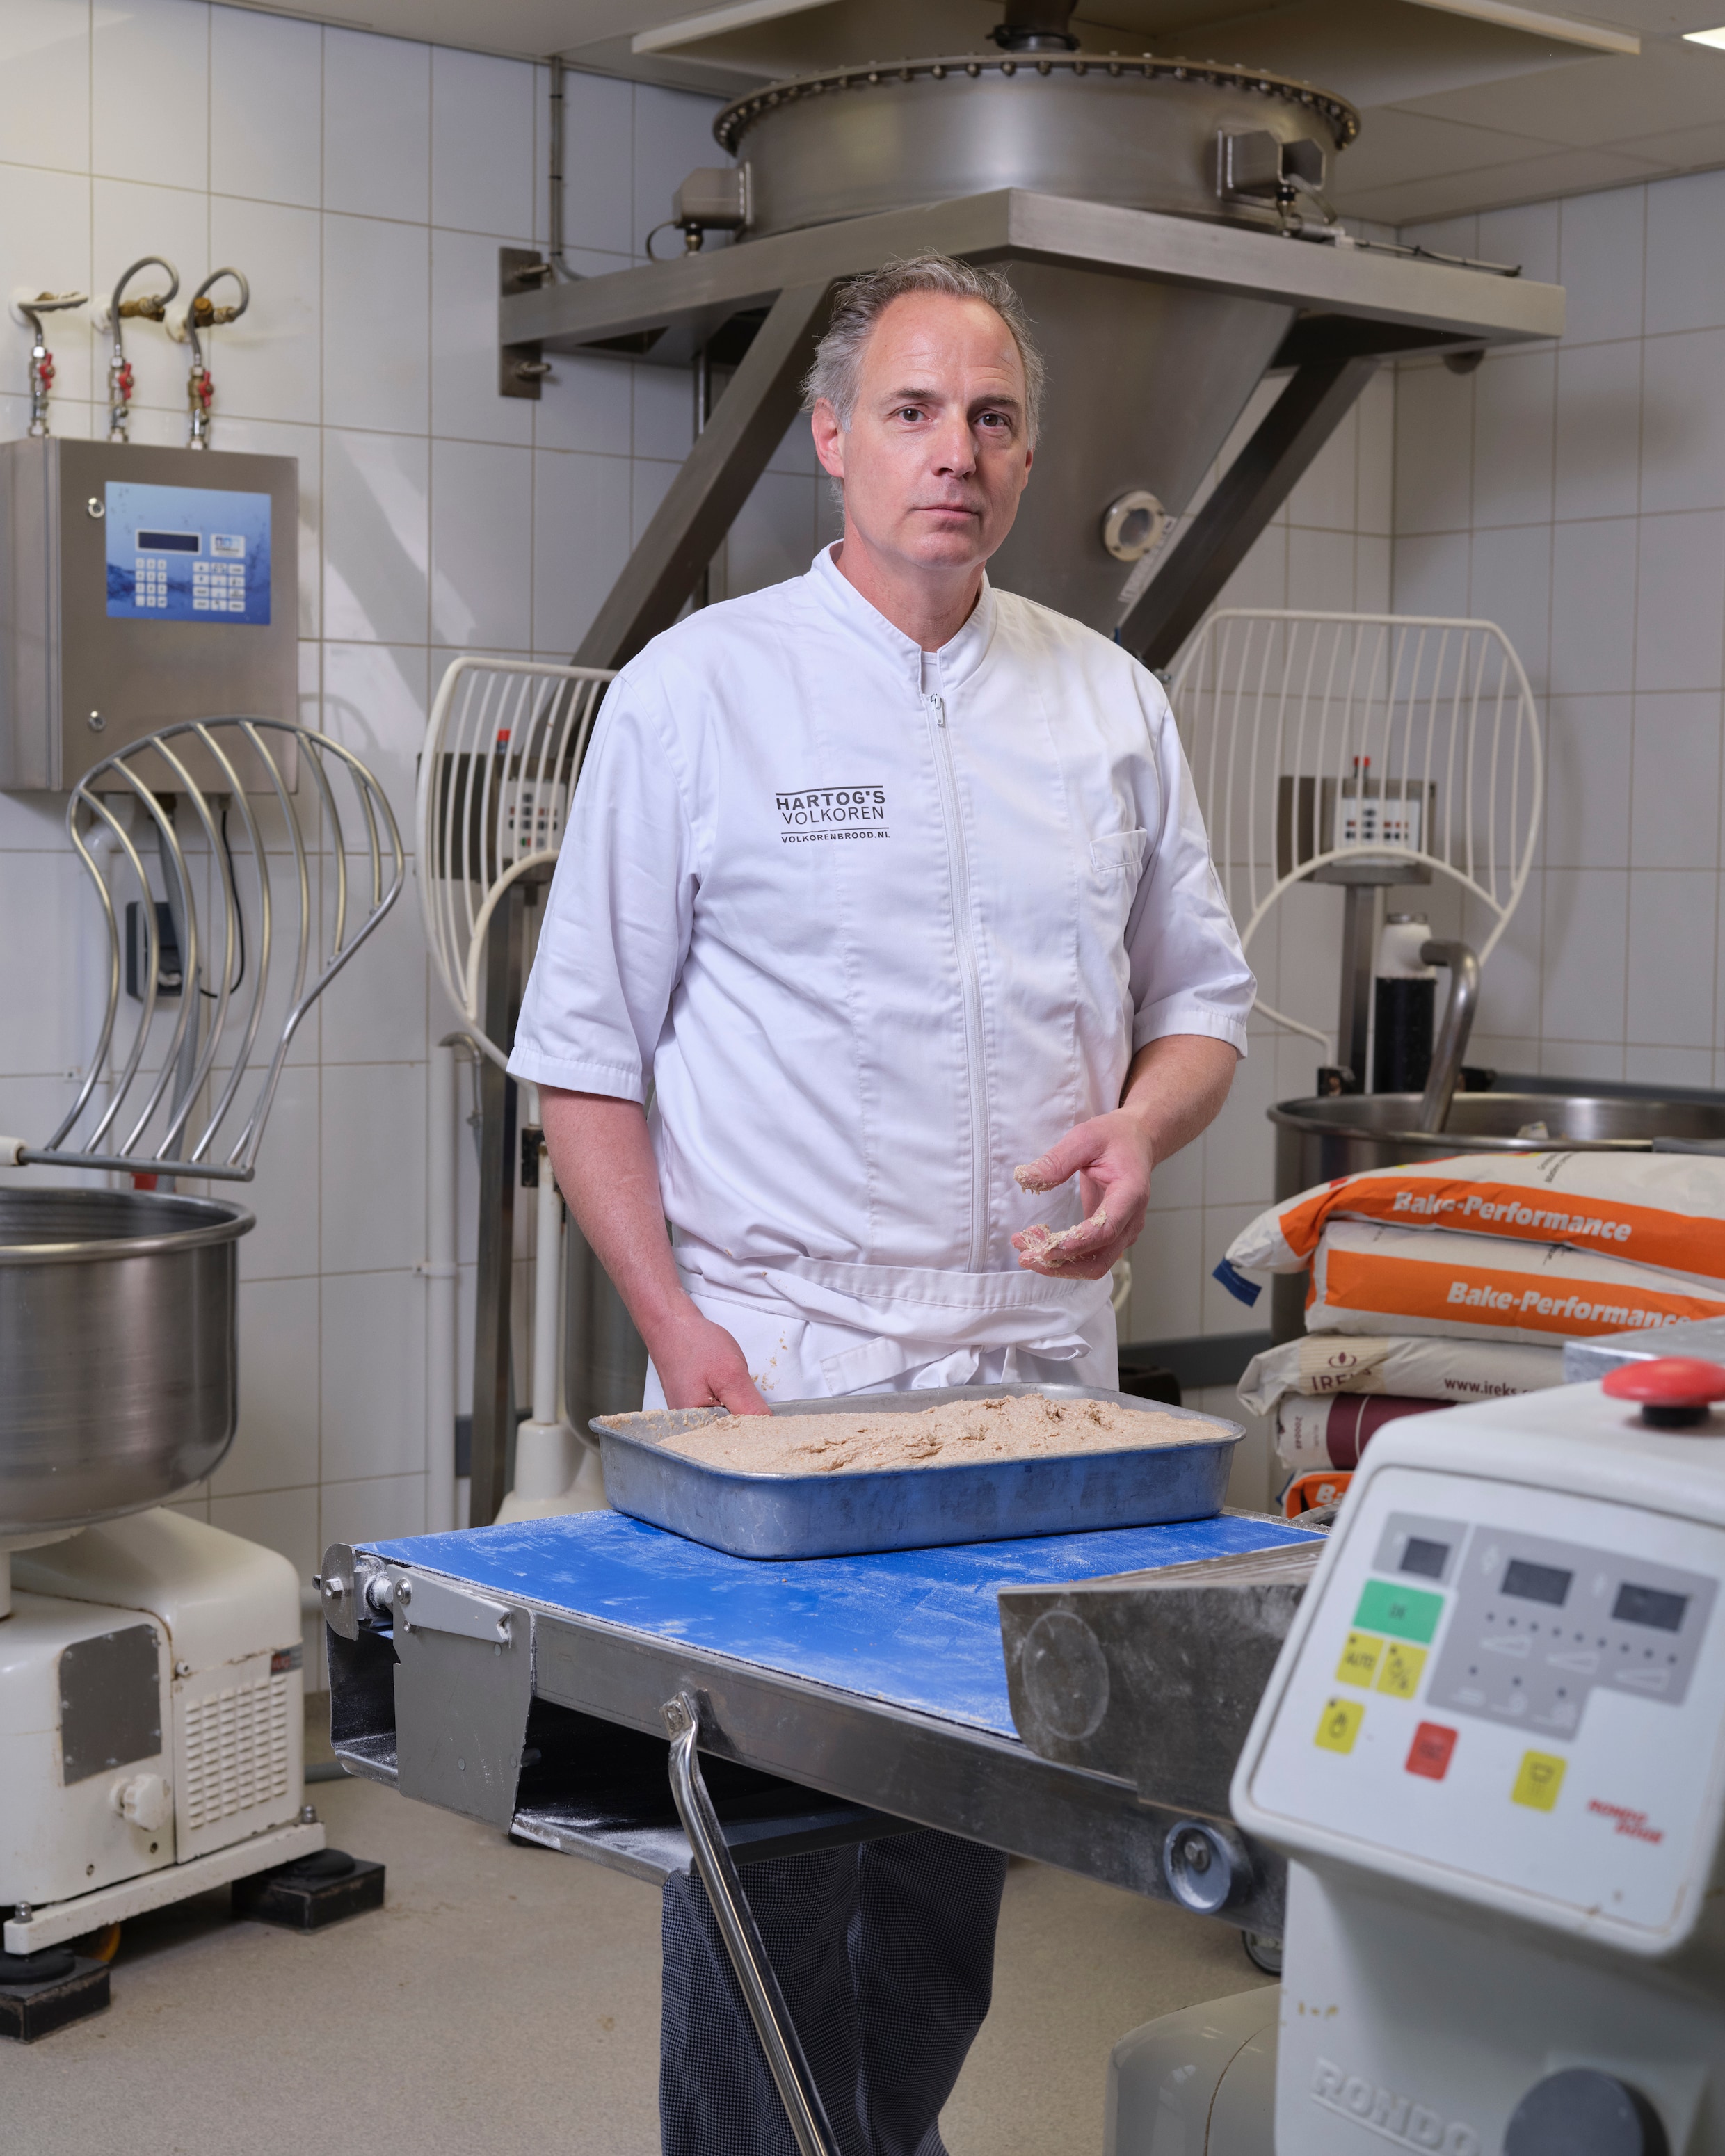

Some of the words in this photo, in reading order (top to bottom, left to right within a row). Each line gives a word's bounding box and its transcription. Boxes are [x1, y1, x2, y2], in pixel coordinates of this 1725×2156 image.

[776, 790, 885, 810] HARTOG'S
[782, 806, 884, 825] VOLKOREN
[781, 831, 890, 844] VOLKORENBROOD.NL
[1393, 1191, 1632, 1242] Bake-Performance
[1310, 2057, 1482, 2156] RONDO
